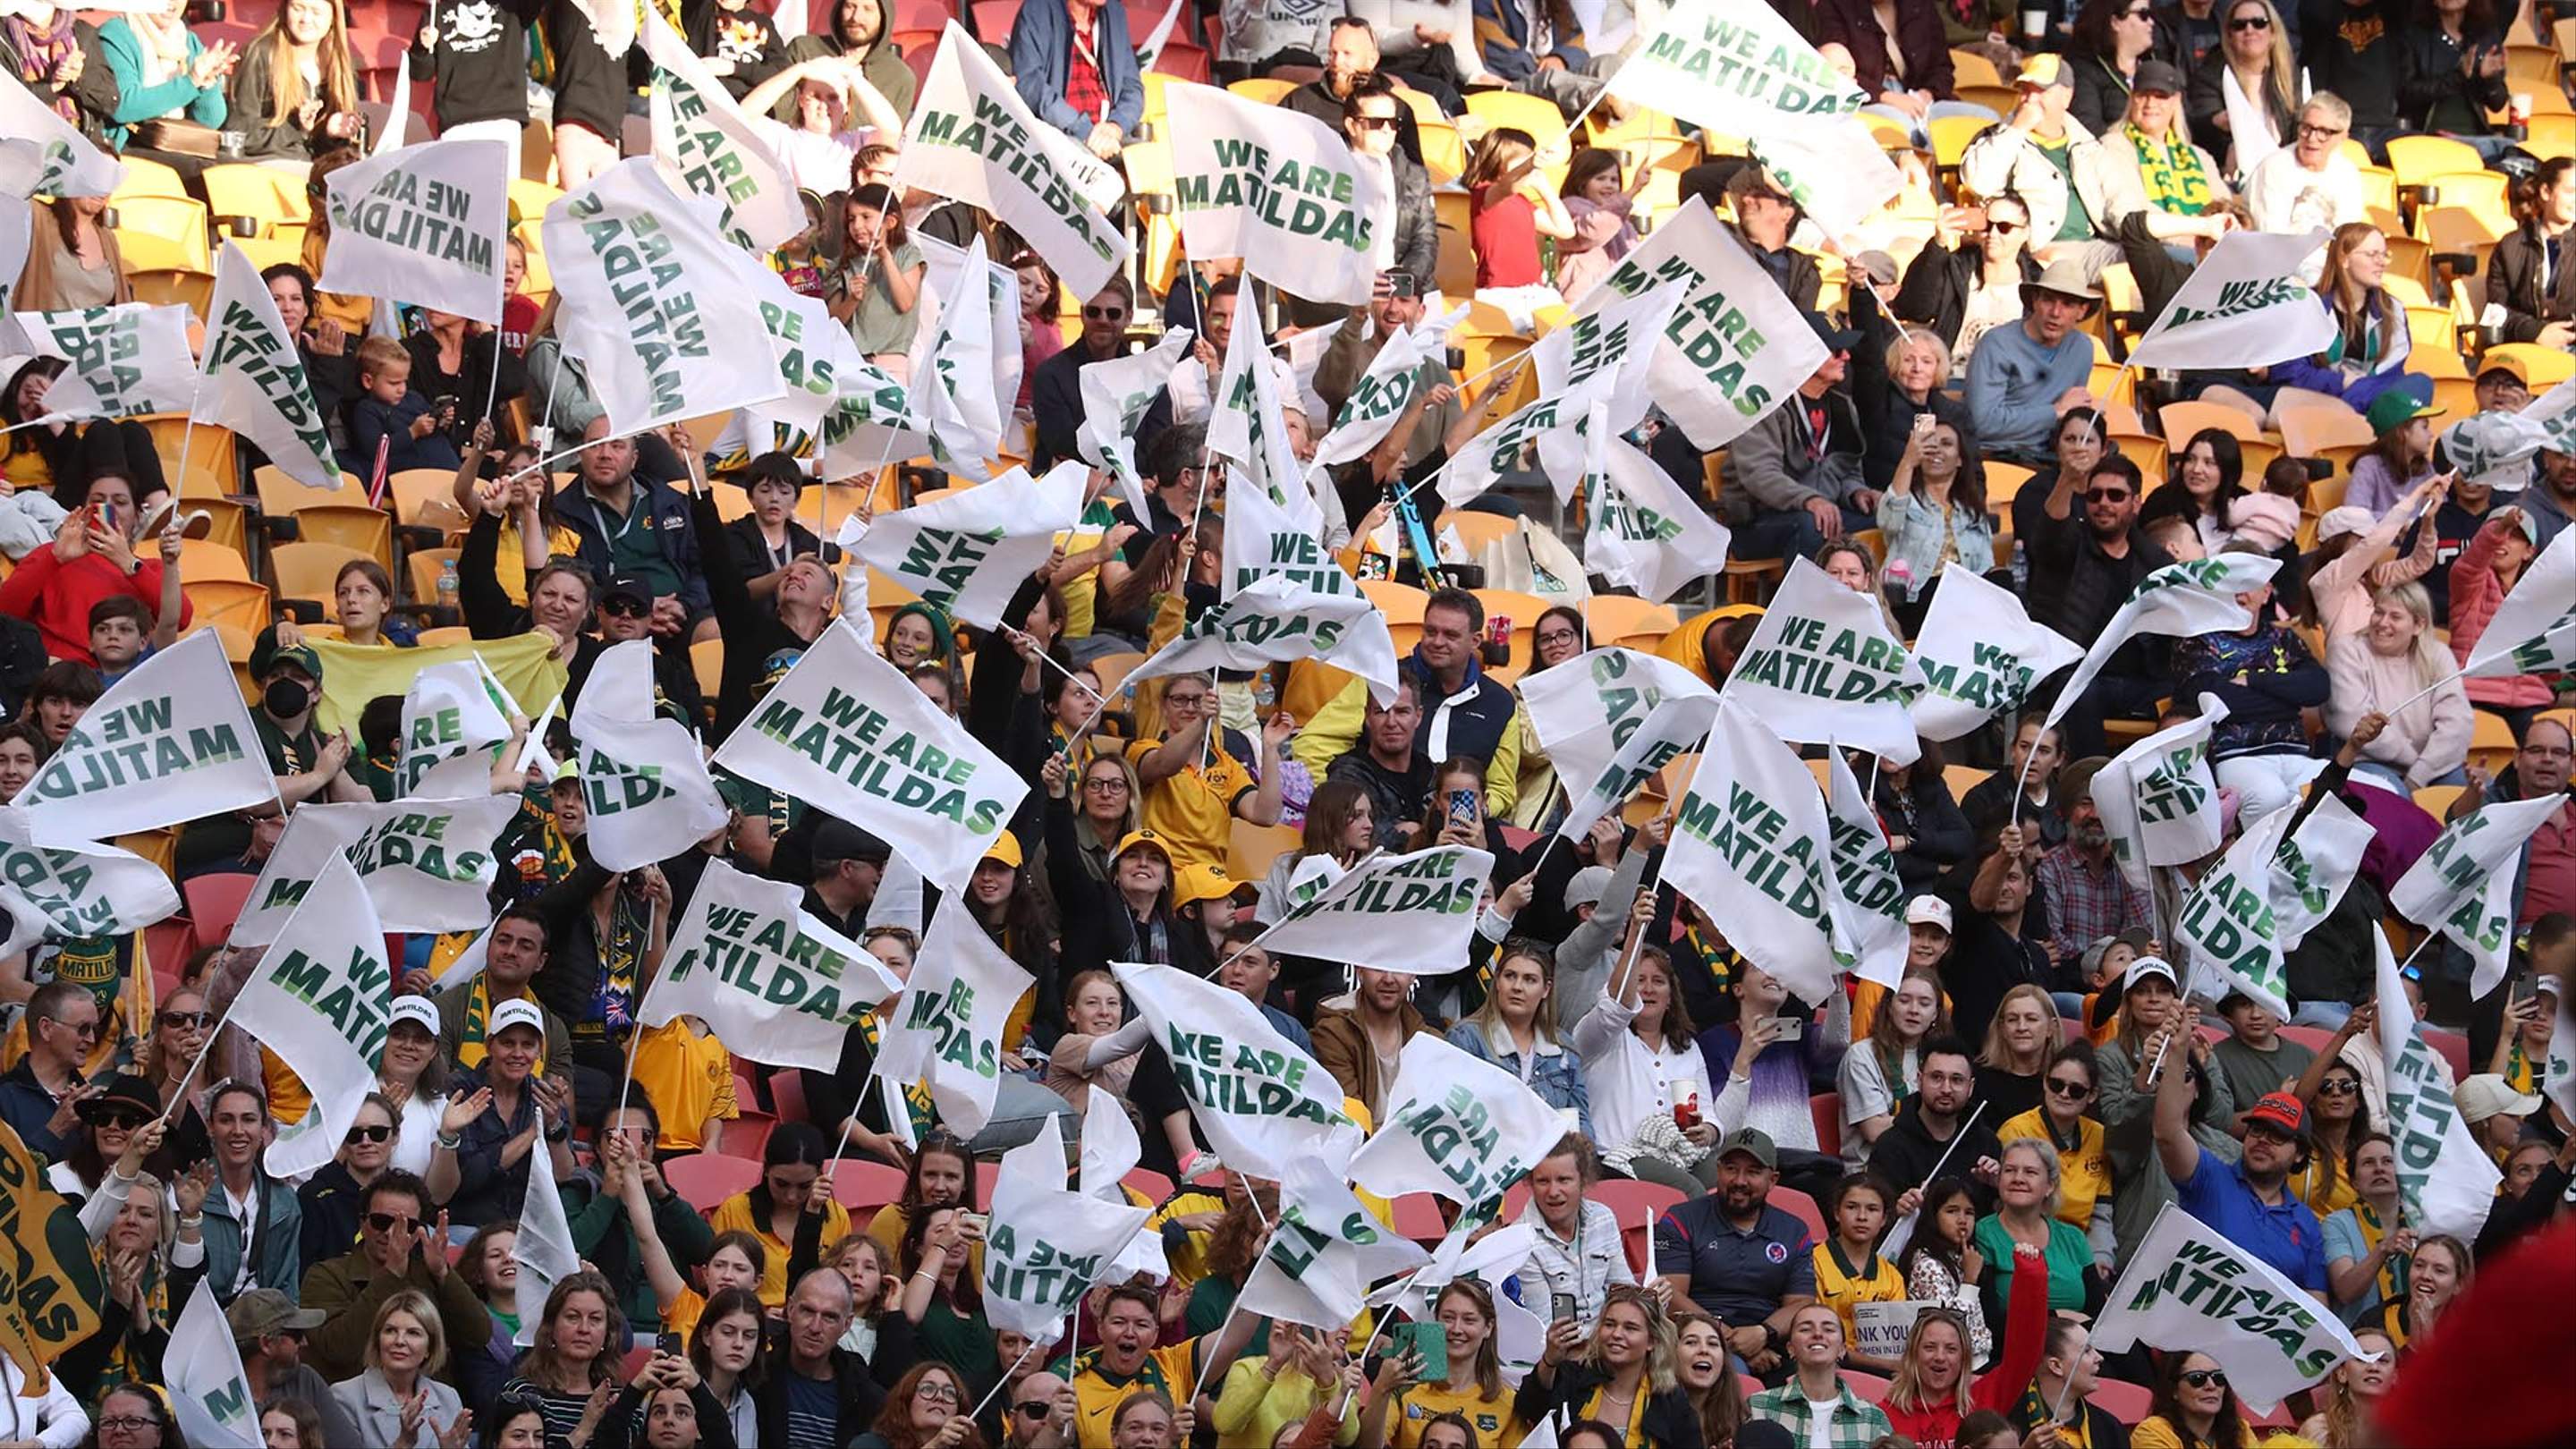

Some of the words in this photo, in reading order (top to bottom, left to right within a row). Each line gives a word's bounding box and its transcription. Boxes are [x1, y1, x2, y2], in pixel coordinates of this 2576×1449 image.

[1702, 14, 1760, 59] WE
[1764, 44, 1838, 90] ARE
[975, 93, 1030, 148] WE
[695, 131, 759, 207] ARE
[916, 111, 1114, 263] MATILDAS
[1213, 139, 1269, 177] WE
[1272, 158, 1354, 205] ARE
[1175, 173, 1373, 253] MATILDAS
[223, 301, 282, 355] WE
[759, 301, 804, 343] RE
[1608, 260, 1772, 417] MLDAS
[1694, 292, 1767, 360] ARE
[206, 329, 341, 477] TILDA
[1270, 532, 1318, 564] WE
[1778, 614, 1826, 651] WE
[1827, 629, 1906, 674] ARE
[410, 708, 463, 751] RE
[820, 686, 888, 746] WE
[883, 732, 977, 785] ARE
[752, 699, 1004, 835] MATILDAS
[374, 812, 453, 843] ARE
[1729, 780, 1788, 845] WE
[260, 835, 487, 911] MILDAS
[1286, 877, 1479, 923] ILDAS
[1385, 851, 1463, 879] ARE
[1674, 791, 1834, 945] MATILDA
[1830, 850, 1907, 926] ILDA
[708, 903, 759, 938] WE
[755, 919, 849, 982] ARE
[2181, 887, 2287, 1000] ILDA
[2209, 872, 2276, 942] ARE
[62, 959, 118, 979] MATIL
[670, 933, 877, 1027] MTILDAS
[946, 977, 974, 1021] RE
[269, 949, 388, 1073] MATI
[1173, 1061, 1355, 1128] ATILDA
[1233, 1045, 1309, 1094] ARE
[2127, 1260, 2337, 1379] MATILDAS
[2176, 1239, 2247, 1279] WE
[2241, 1284, 2318, 1330] ARE
